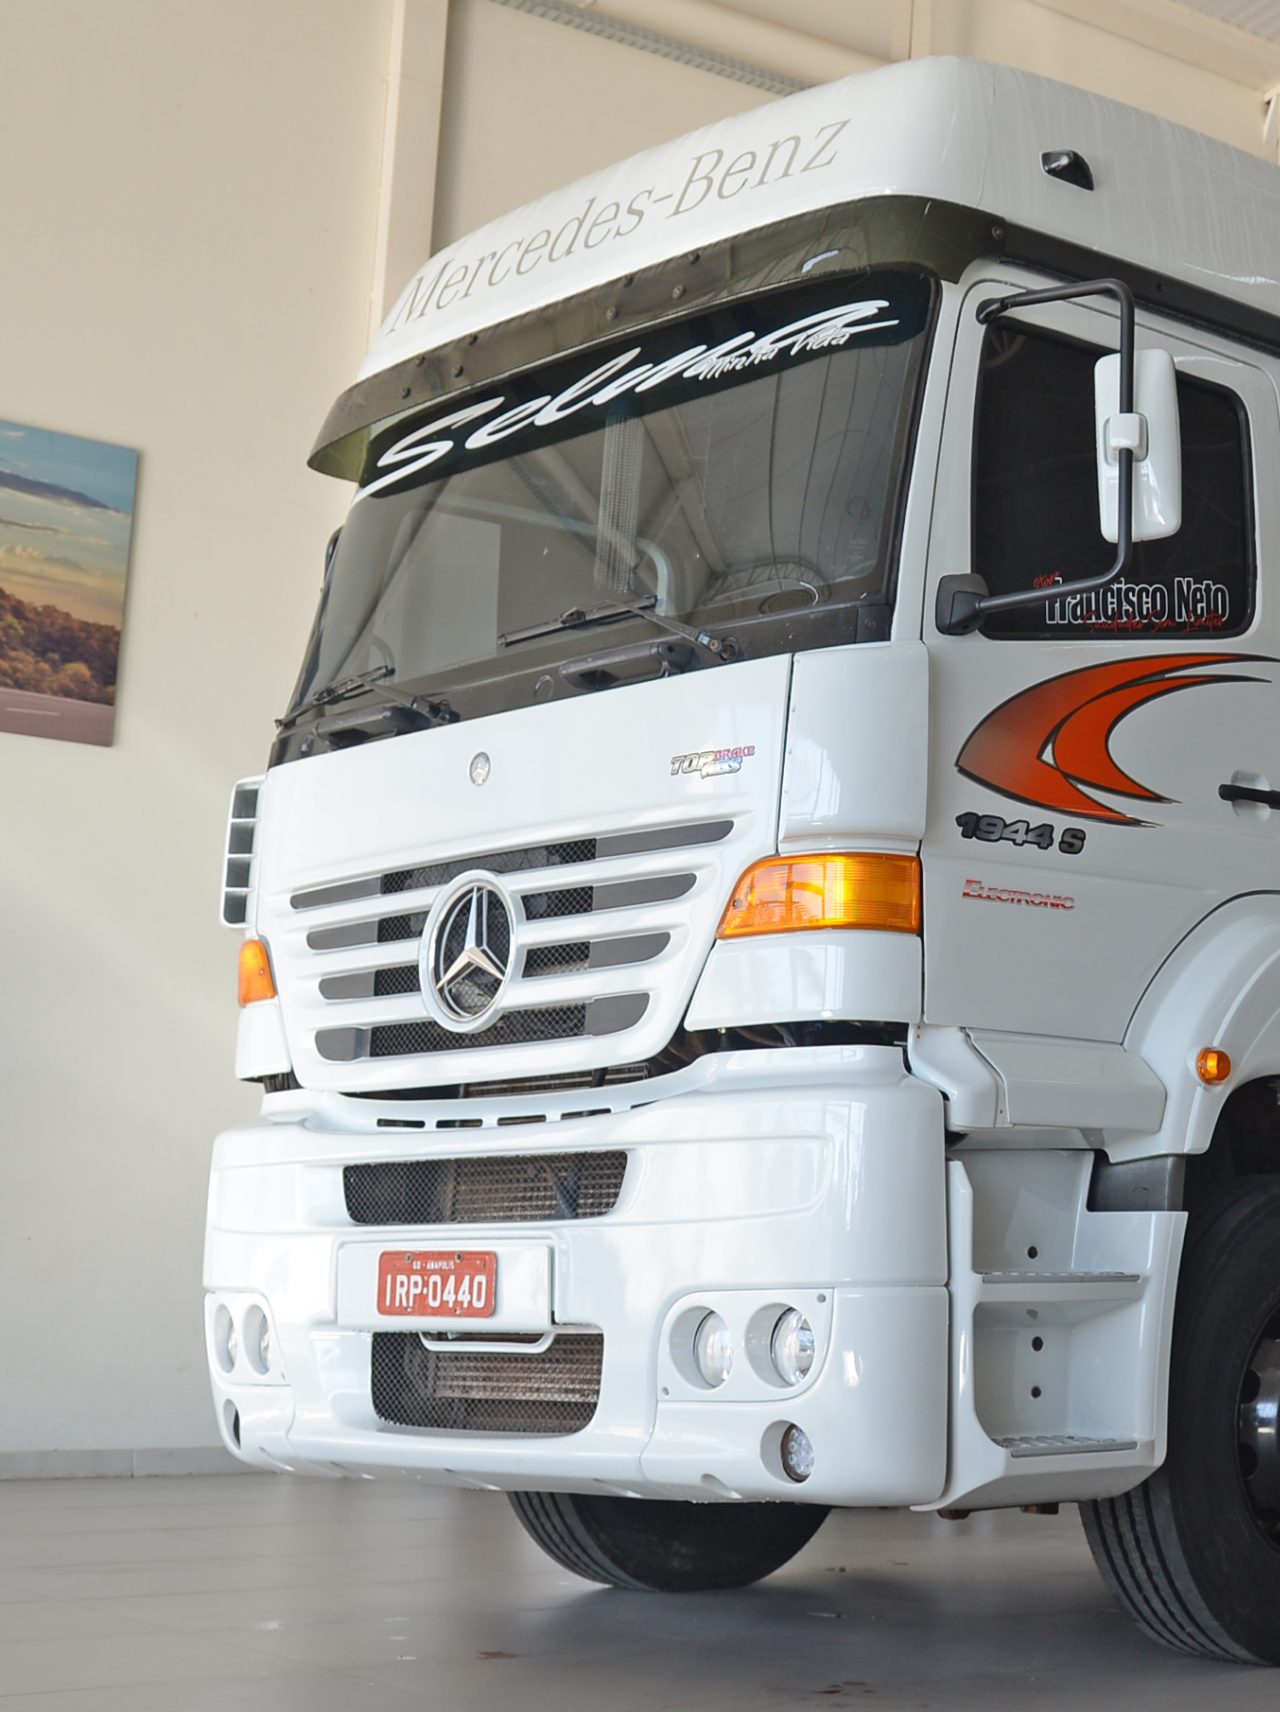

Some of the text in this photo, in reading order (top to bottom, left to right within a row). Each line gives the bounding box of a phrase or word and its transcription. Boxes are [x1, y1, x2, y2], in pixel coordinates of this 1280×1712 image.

[385, 118, 852, 335] Mercedes-Benz
[1173, 576, 1230, 623] Neto
[671, 745, 755, 776] TOP BRAKE
[955, 811, 1086, 855] 1944 S
